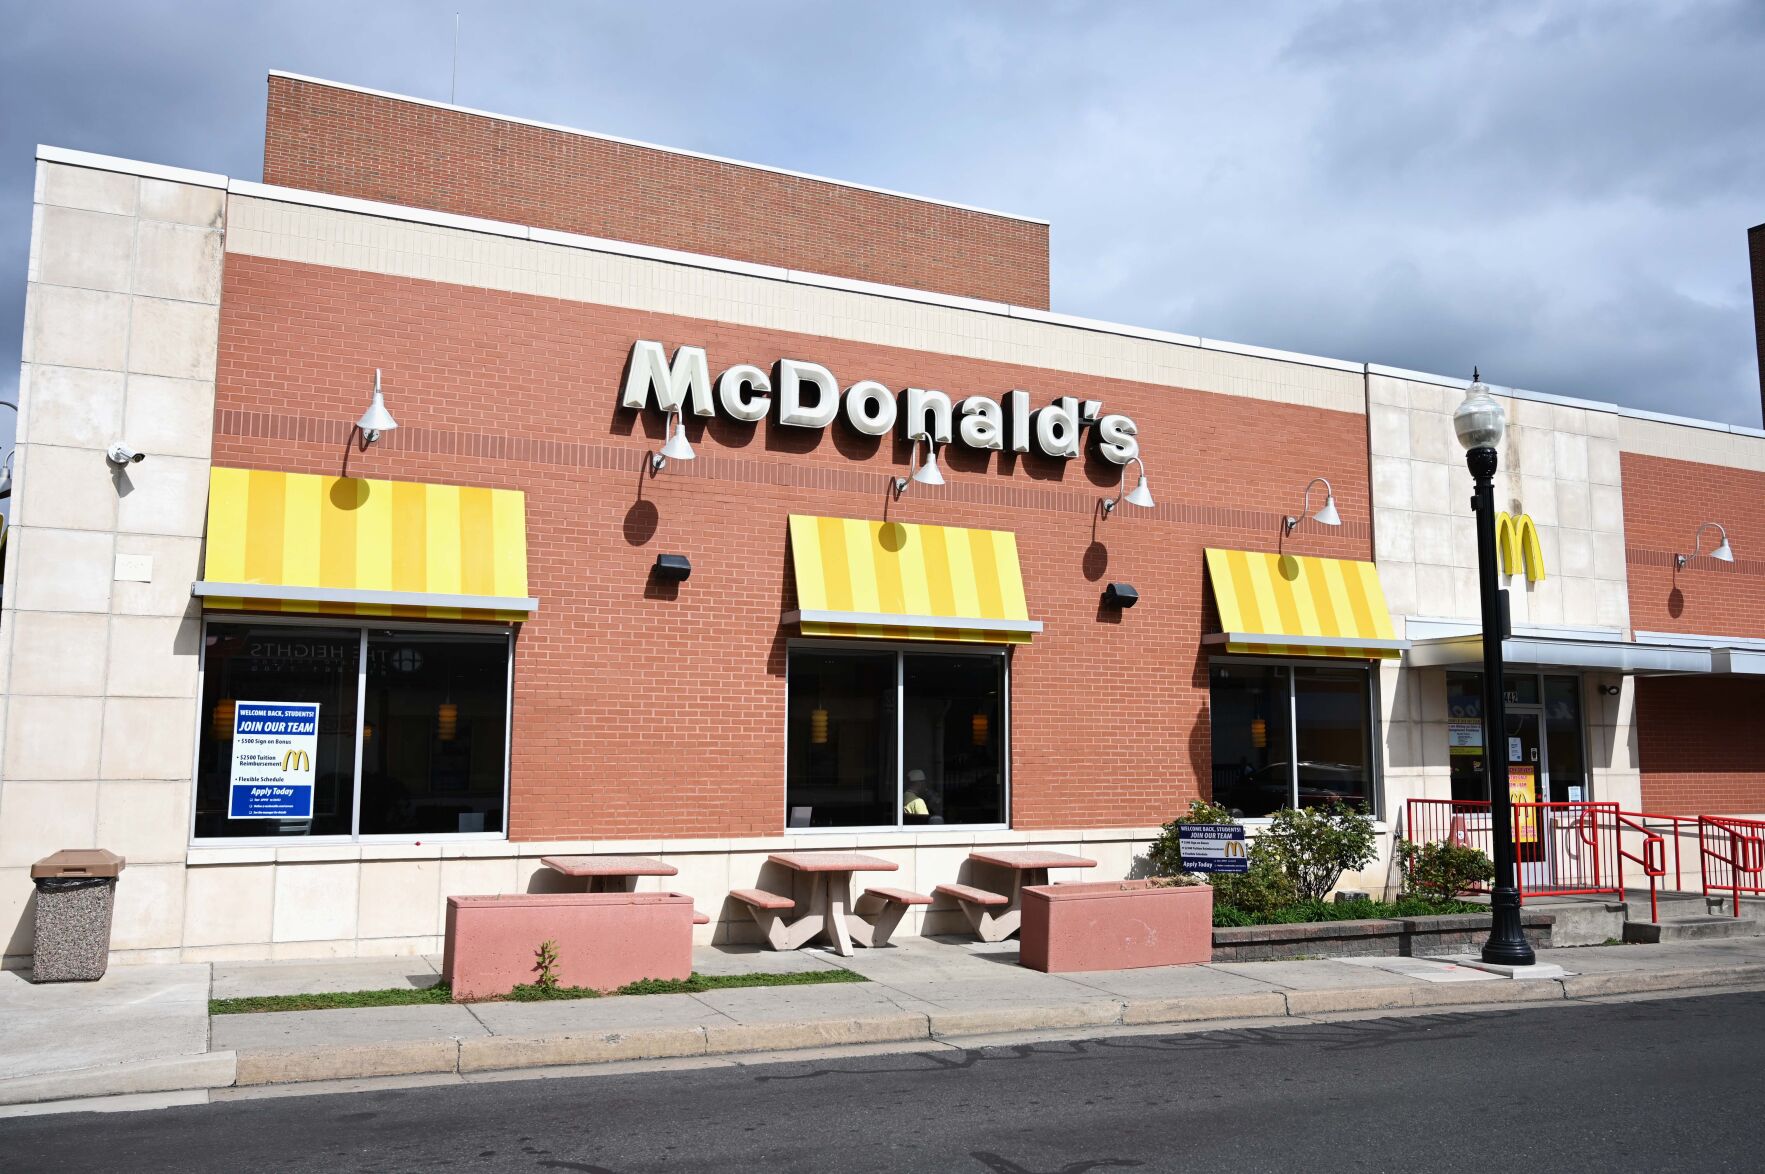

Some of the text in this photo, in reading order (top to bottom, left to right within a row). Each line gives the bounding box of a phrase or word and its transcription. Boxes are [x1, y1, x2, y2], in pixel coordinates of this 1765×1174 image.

[622, 340, 1139, 464] McDonald's
[240, 709, 267, 717] WELCOME
[238, 721, 314, 733] JOIN OUR TEAM
[250, 787, 294, 797] Apply Today
